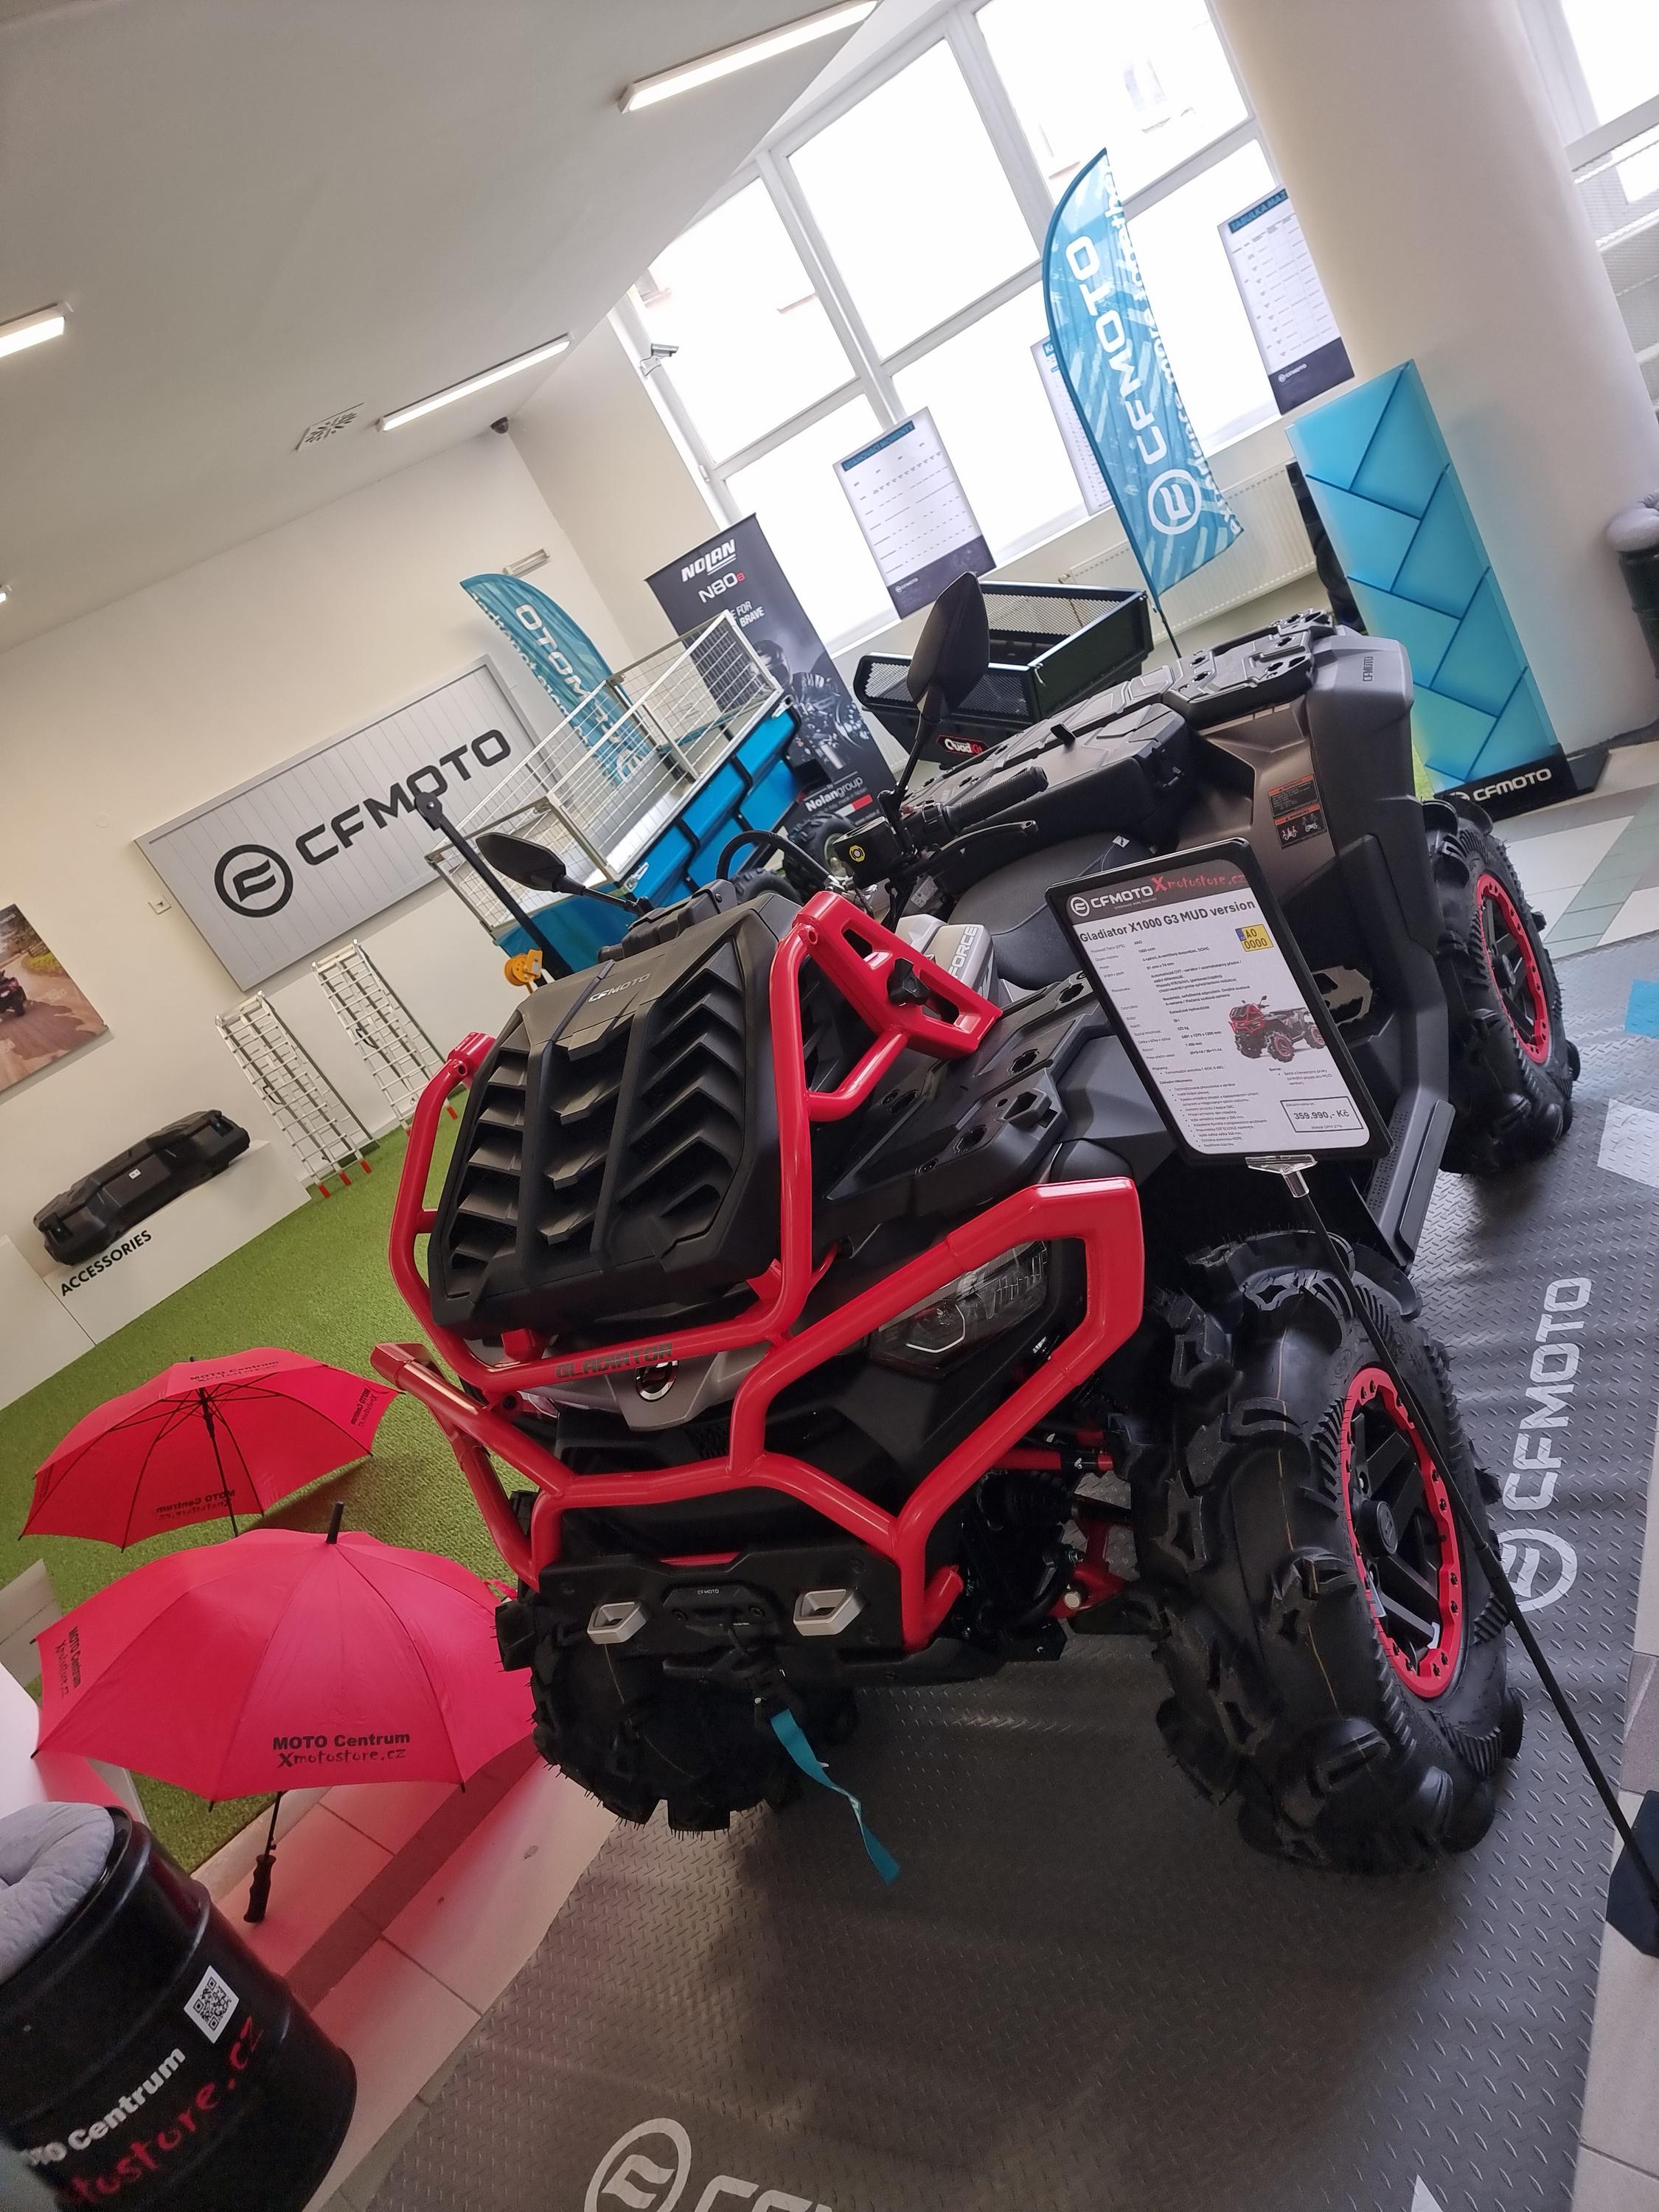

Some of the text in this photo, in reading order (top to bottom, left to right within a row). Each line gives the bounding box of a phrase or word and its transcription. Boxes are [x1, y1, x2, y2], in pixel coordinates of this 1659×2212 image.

[1065, 236, 1167, 465] CFMOTO
[681, 539, 737, 582] NOLAN
[736, 601, 752, 616] FOR
[739, 606, 765, 627] BRAVE
[1363, 656, 1374, 682] CFMOTO
[295, 729, 511, 866] CFMOTO
[805, 777, 863, 812] Nolangroup
[1473, 768, 1552, 801] CFMOTO
[1090, 886, 1154, 908] CFMOTO
[1079, 900, 1256, 942] Gladiator X1000 G3 MUD version
[588, 973, 650, 1002] CFMOTO
[1293, 1109, 1349, 1120] 359.990,- Kč
[60, 1230, 153, 1296] ACCESSORIES
[555, 1343, 672, 1379] GLADIATOR
[1502, 1276, 1592, 1511] CFMOTO
[273, 1733, 410, 1750] MOTO Centrum
[277, 1748, 406, 1769] Xmotostore.cz
[68, 2048, 186, 2151] Centrum
